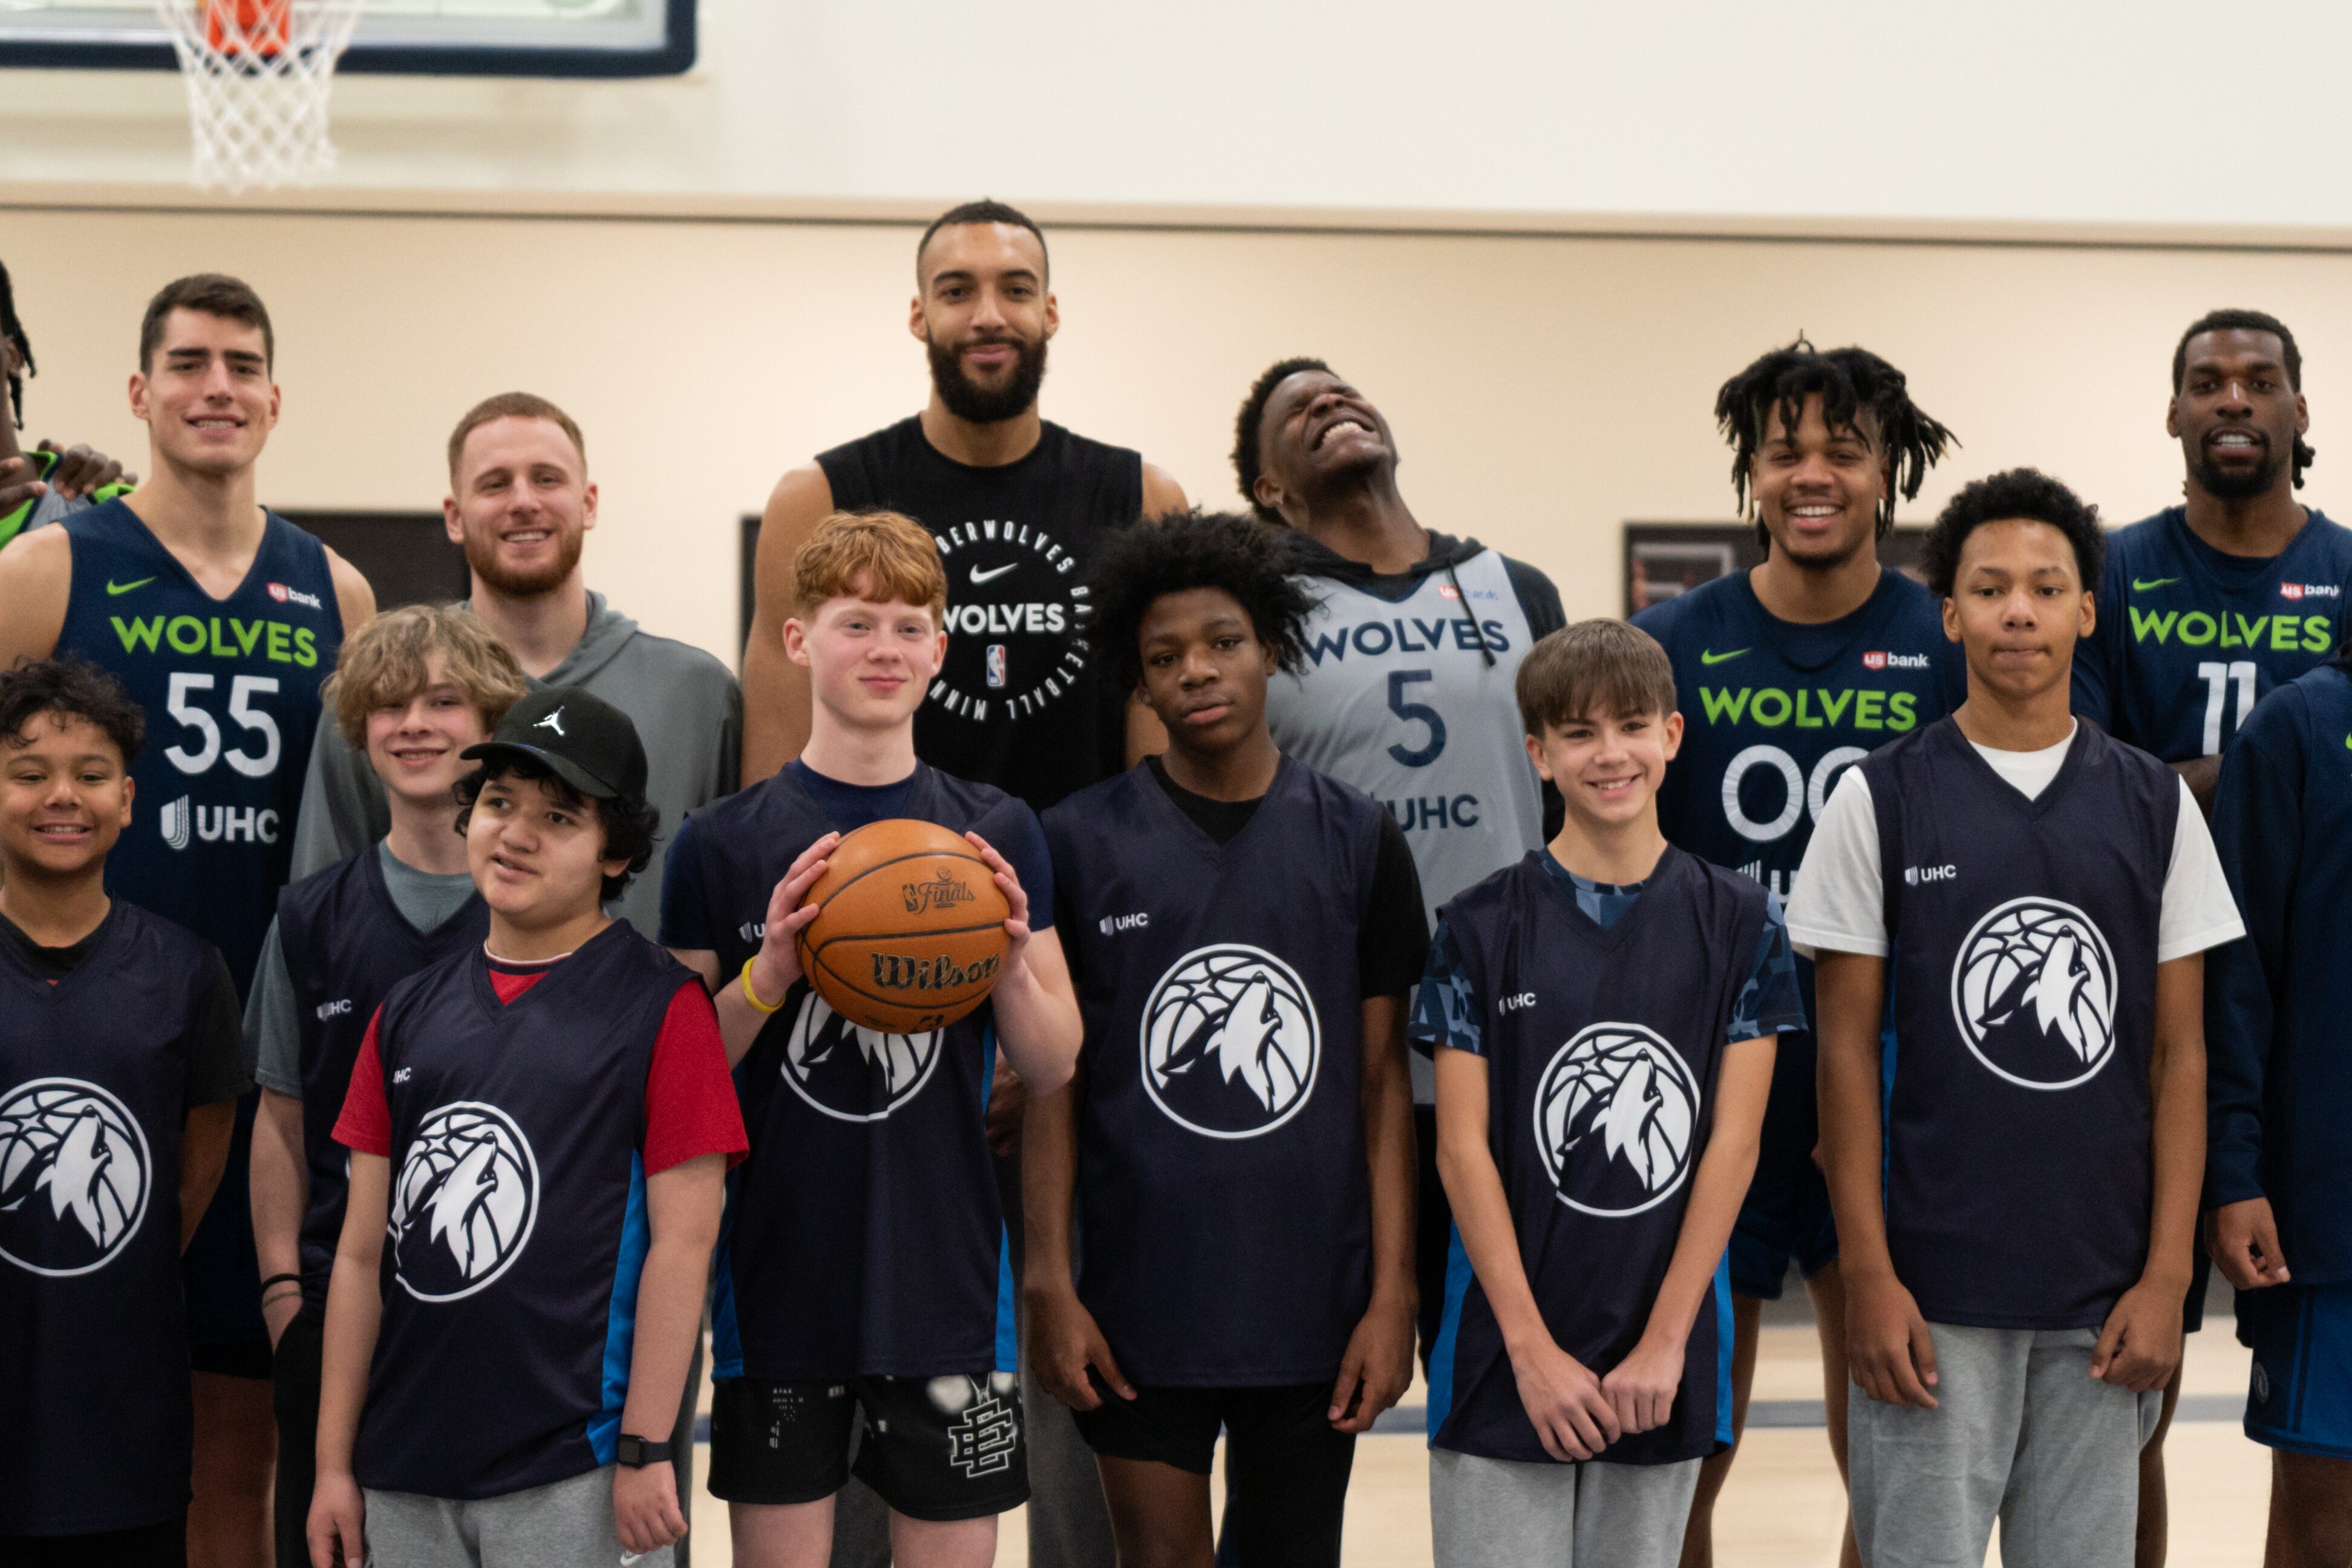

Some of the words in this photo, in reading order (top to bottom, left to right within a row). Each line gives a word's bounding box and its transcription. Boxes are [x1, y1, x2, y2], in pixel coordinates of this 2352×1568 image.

[935, 520, 1074, 573] BERWOLVES
[110, 615, 318, 668] WOLVES
[1299, 618, 1509, 667] WOLVES
[2129, 606, 2331, 652] WOLVES
[1887, 652, 1928, 667] bank
[164, 671, 281, 777] 55
[1387, 669, 1447, 768] 5
[1699, 687, 1917, 732] WOLVES
[2198, 661, 2256, 756] 11
[197, 805, 279, 843] UHC
[1387, 794, 1479, 832] UHC
[1920, 864, 1957, 883] UHC
[917, 881, 976, 915] Finals
[1115, 912, 1149, 930] UHC
[871, 951, 1000, 990] Wilson
[1507, 992, 1536, 1010] UHC
